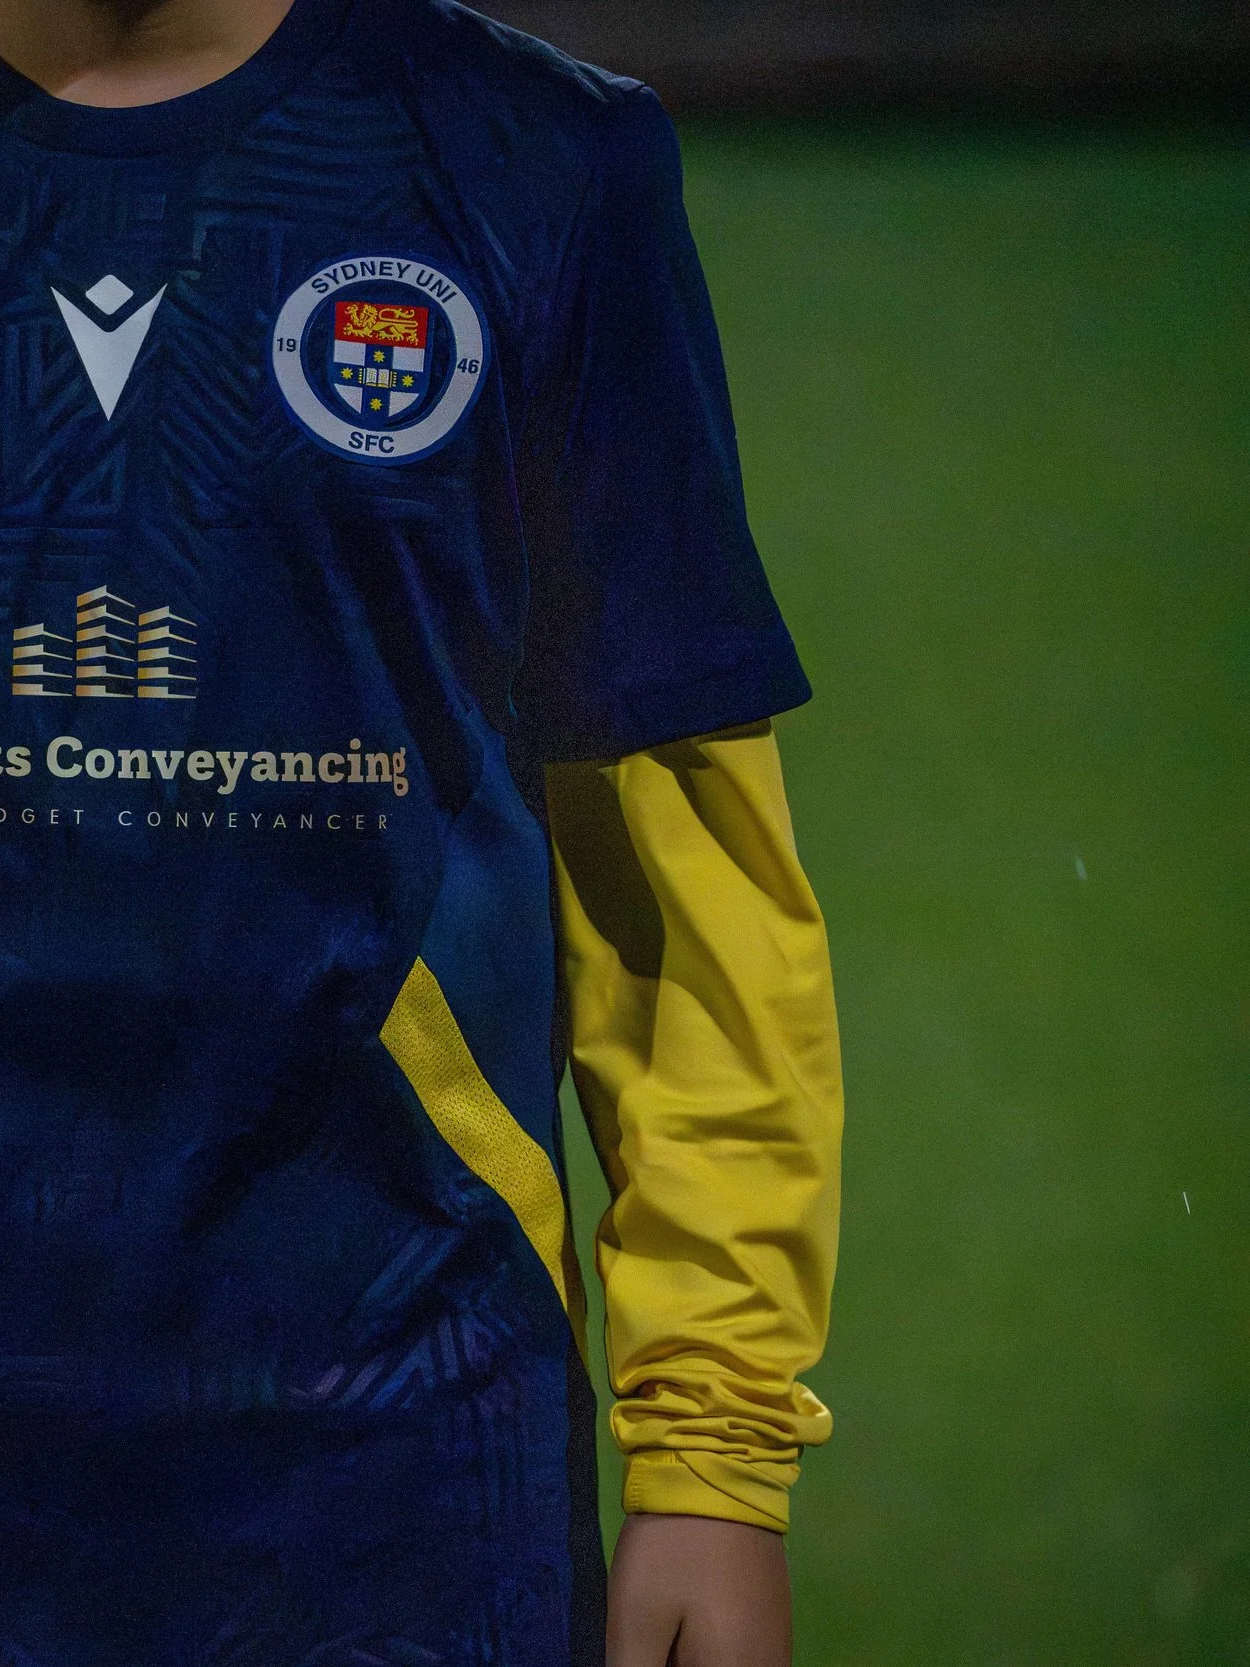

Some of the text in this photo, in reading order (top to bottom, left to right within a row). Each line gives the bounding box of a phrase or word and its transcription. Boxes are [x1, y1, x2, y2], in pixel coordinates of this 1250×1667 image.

[311, 261, 458, 304] SYDNEY UNI
[276, 337, 297, 353] 19
[457, 358, 480, 374] 46
[348, 431, 395, 454] SFC
[46, 736, 409, 797] Conveyancing
[118, 811, 387, 830] CONVEYANCER
